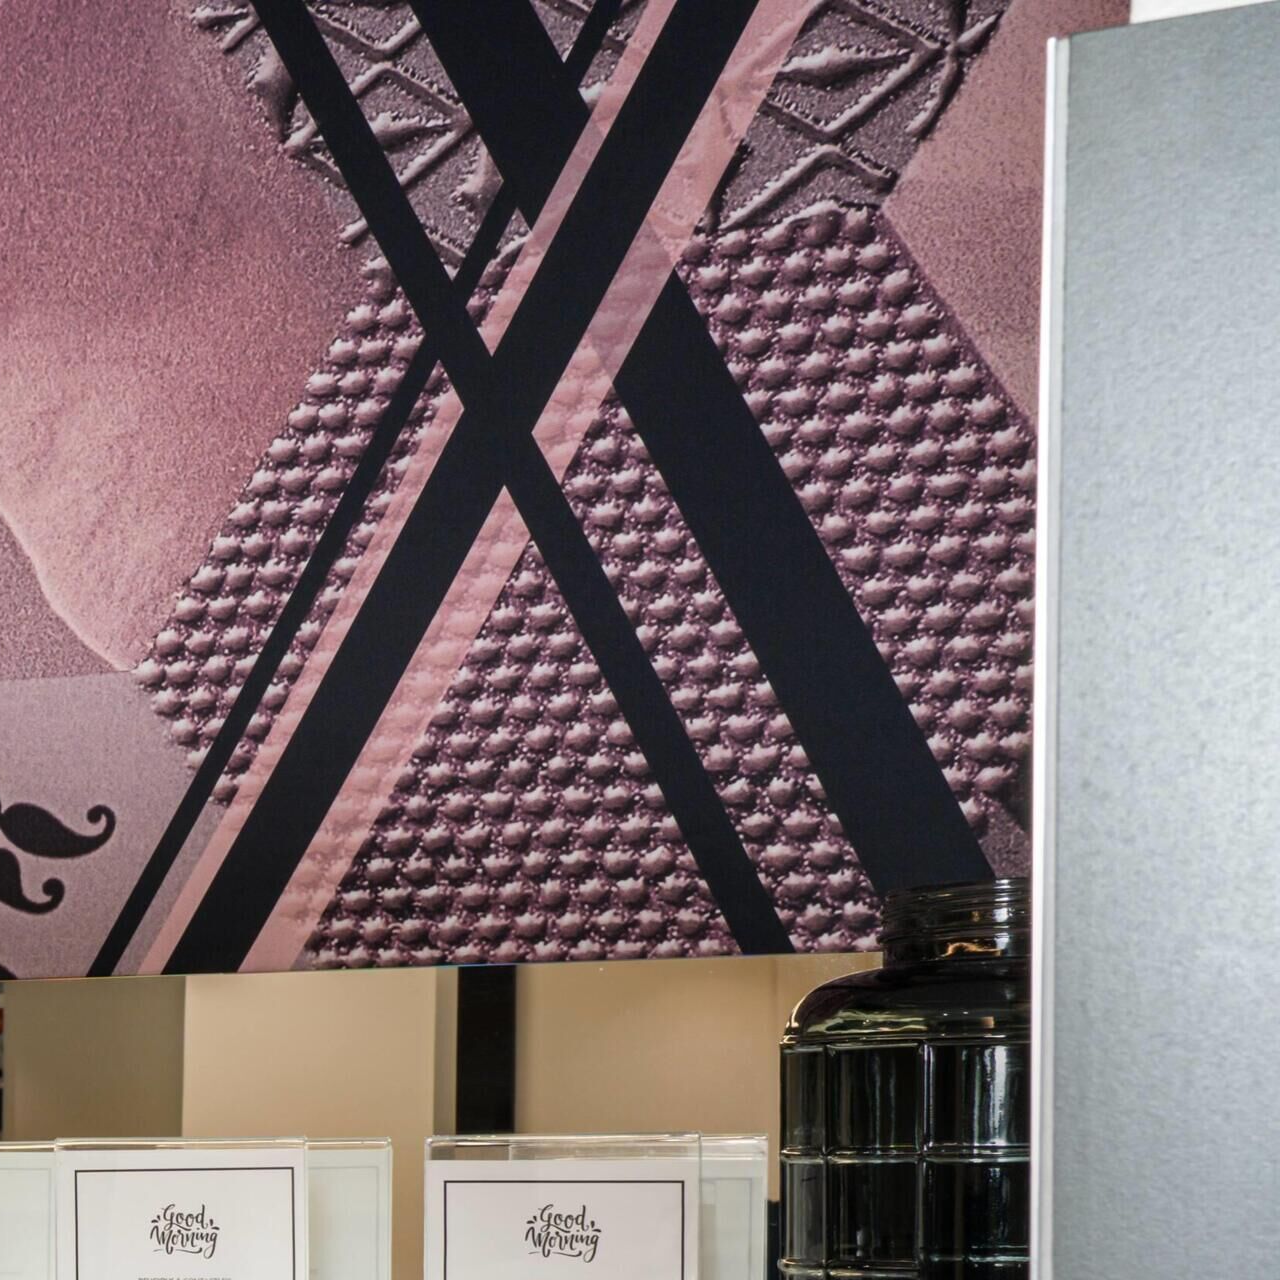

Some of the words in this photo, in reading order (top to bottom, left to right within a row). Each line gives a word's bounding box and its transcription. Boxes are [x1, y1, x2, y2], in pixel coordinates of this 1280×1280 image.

[162, 1204, 208, 1231] Good
[538, 1204, 589, 1233] Good
[150, 1225, 218, 1259] Morning
[525, 1227, 600, 1263] Morning
